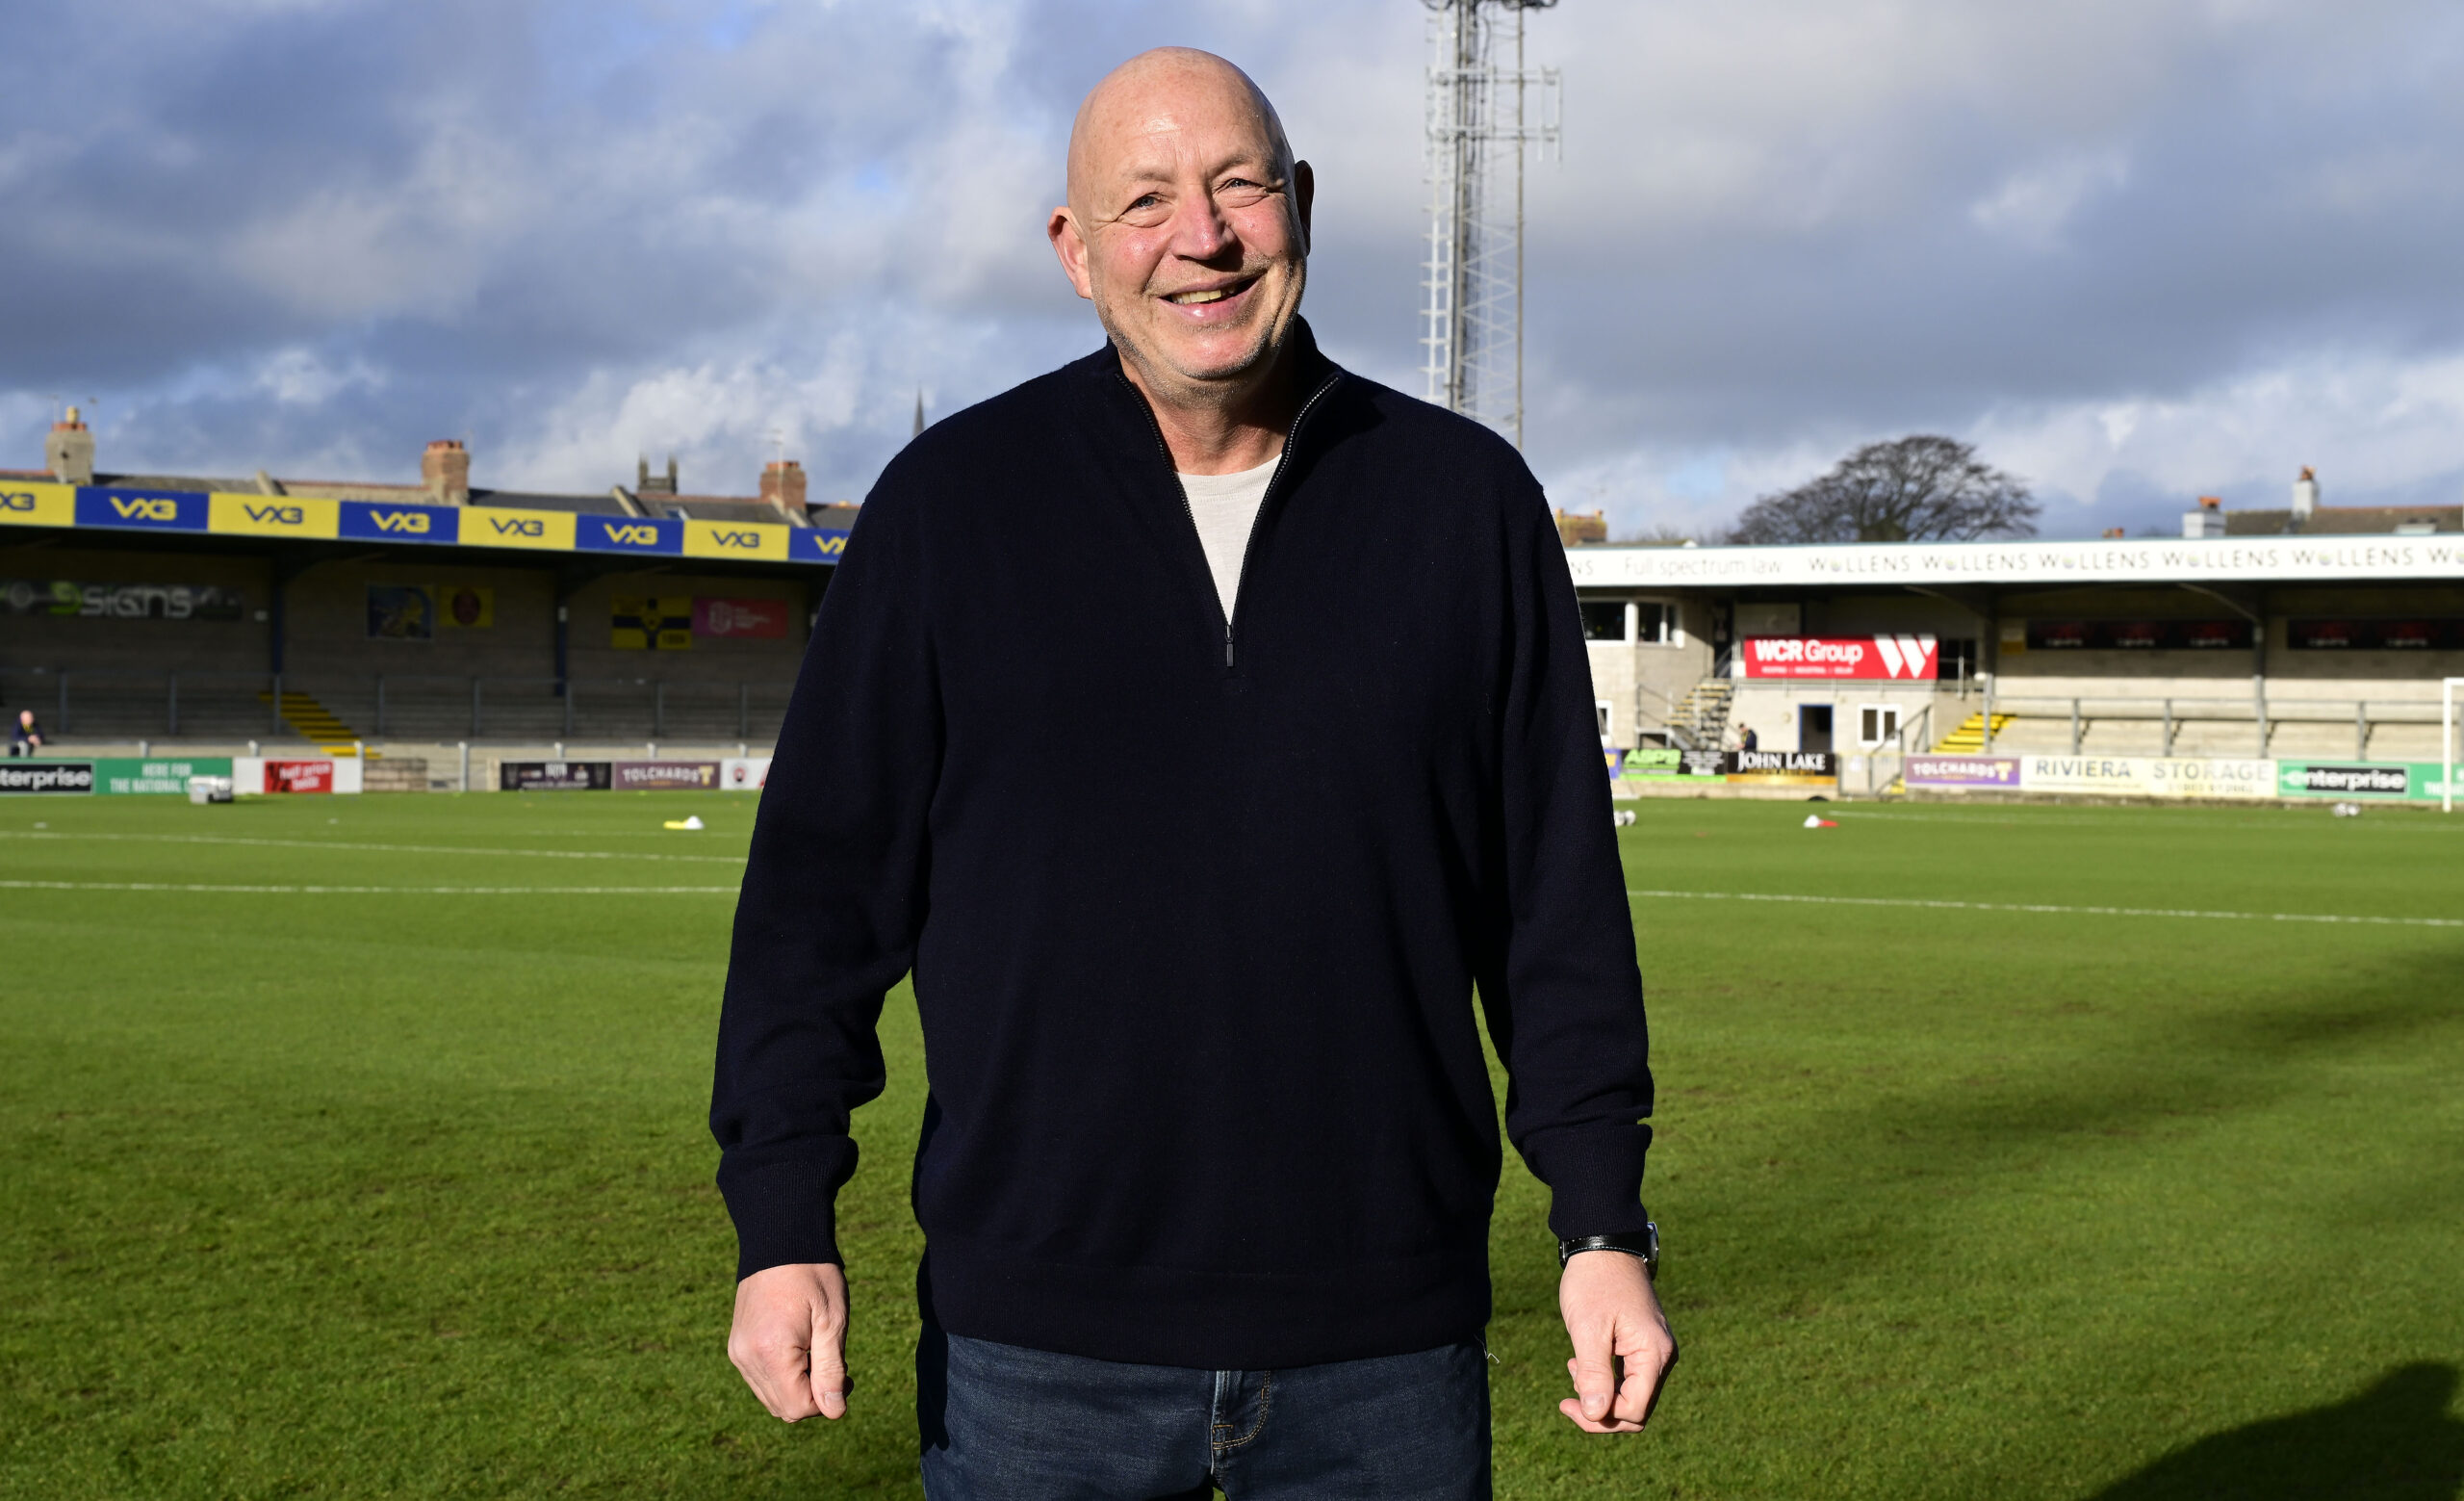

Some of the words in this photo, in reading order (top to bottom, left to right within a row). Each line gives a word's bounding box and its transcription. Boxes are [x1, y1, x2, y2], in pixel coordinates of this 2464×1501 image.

[0, 492, 36, 511] X3
[110, 496, 177, 521] VX3
[244, 505, 303, 525] VX3
[370, 509, 430, 533] VX3
[490, 518, 544, 537] VX3
[603, 523, 658, 546] VX3
[711, 531, 761, 549] VX3
[814, 534, 848, 555] VX
[1625, 556, 1656, 575] Full
[1659, 557, 1746, 578] spectrum
[1752, 556, 1782, 574] law
[1810, 555, 1911, 573] WOLLENS
[1922, 555, 2028, 571] WOLLENS
[2039, 552, 2149, 570] WOLLENS
[2163, 550, 2278, 568] WOLLENS
[2293, 547, 2414, 567] WOLLENS
[1755, 639, 1804, 661] WCR
[1805, 639, 1863, 665] Group
[142, 763, 168, 778] HERE
[171, 763, 192, 778] FOR
[1737, 750, 1783, 772] JOHN
[1785, 752, 1826, 770] LAKE
[1912, 761, 1996, 779] TOLCHARDS
[2036, 760, 2132, 778] RIVIERA
[2152, 762, 2271, 781] STORAGE
[0, 767, 91, 790] terprise
[623, 766, 700, 784] TOLCHARDS
[2282, 769, 2406, 791] enterprise
[110, 778, 130, 793] THE
[132, 778, 181, 793] NATIONAL
